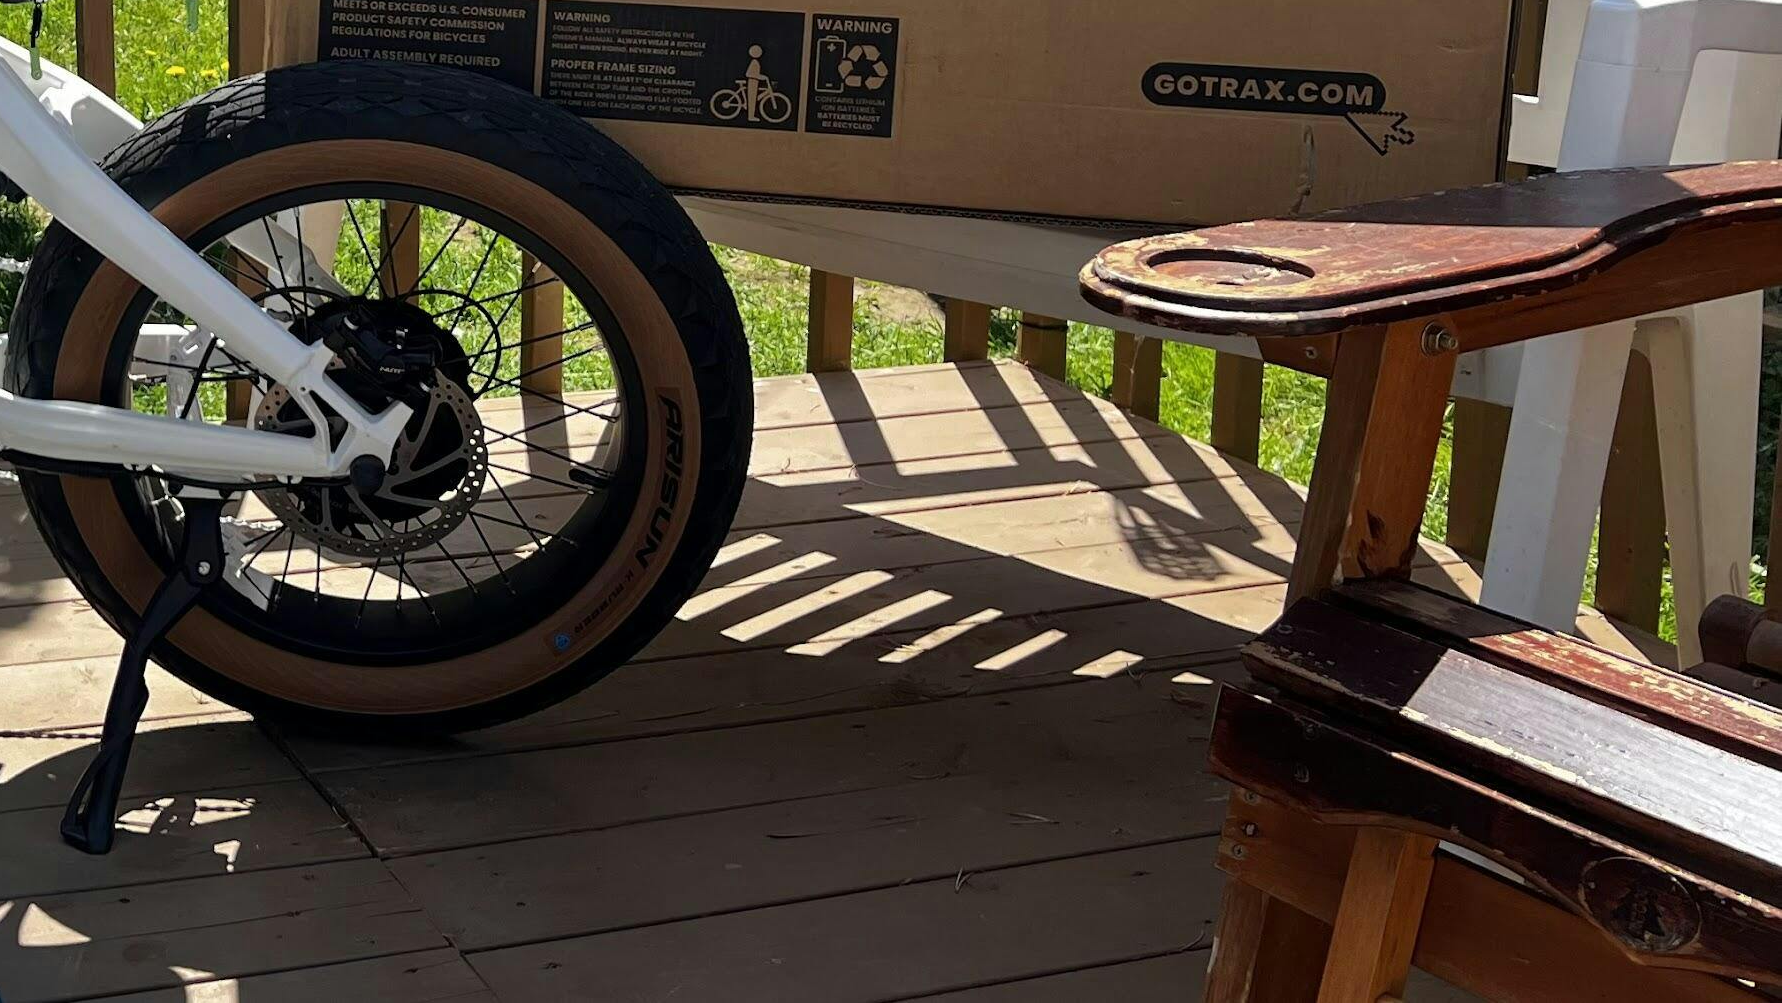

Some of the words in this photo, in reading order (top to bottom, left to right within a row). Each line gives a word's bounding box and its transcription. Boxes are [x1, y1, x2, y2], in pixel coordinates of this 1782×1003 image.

[369, 0, 386, 11] OR
[387, 1, 436, 13] EXCEEDS
[438, 4, 459, 15] U.S.
[461, 5, 526, 18] CONSUMER
[554, 11, 611, 23] WARNING
[332, 11, 384, 24] PRODUCT
[386, 14, 427, 26] SAFETY
[429, 17, 504, 30] COMMISSION
[817, 18, 893, 34] WARNING
[331, 25, 407, 39] REGULATIONS
[408, 29, 431, 40] FOR
[433, 30, 486, 43] BICYCLES
[617, 37, 647, 45] ALWAYS
[676, 41, 705, 49] BICYCLE
[329, 46, 370, 59] ADULT
[372, 48, 437, 63] ASSEMBLY
[438, 52, 500, 66] REQUIRED
[551, 58, 595, 70] PROPER
[596, 60, 636, 73] FRAME
[637, 63, 676, 75] SIZING
[612, 75, 634, 83] LEAST
[653, 77, 695, 87] CLEARANCE
[1153, 73, 1374, 107] GOTRAX.COM
[816, 111, 857, 120] BATTERIES
[858, 114, 880, 122] MUST
[635, 394, 684, 571] ARISUN
